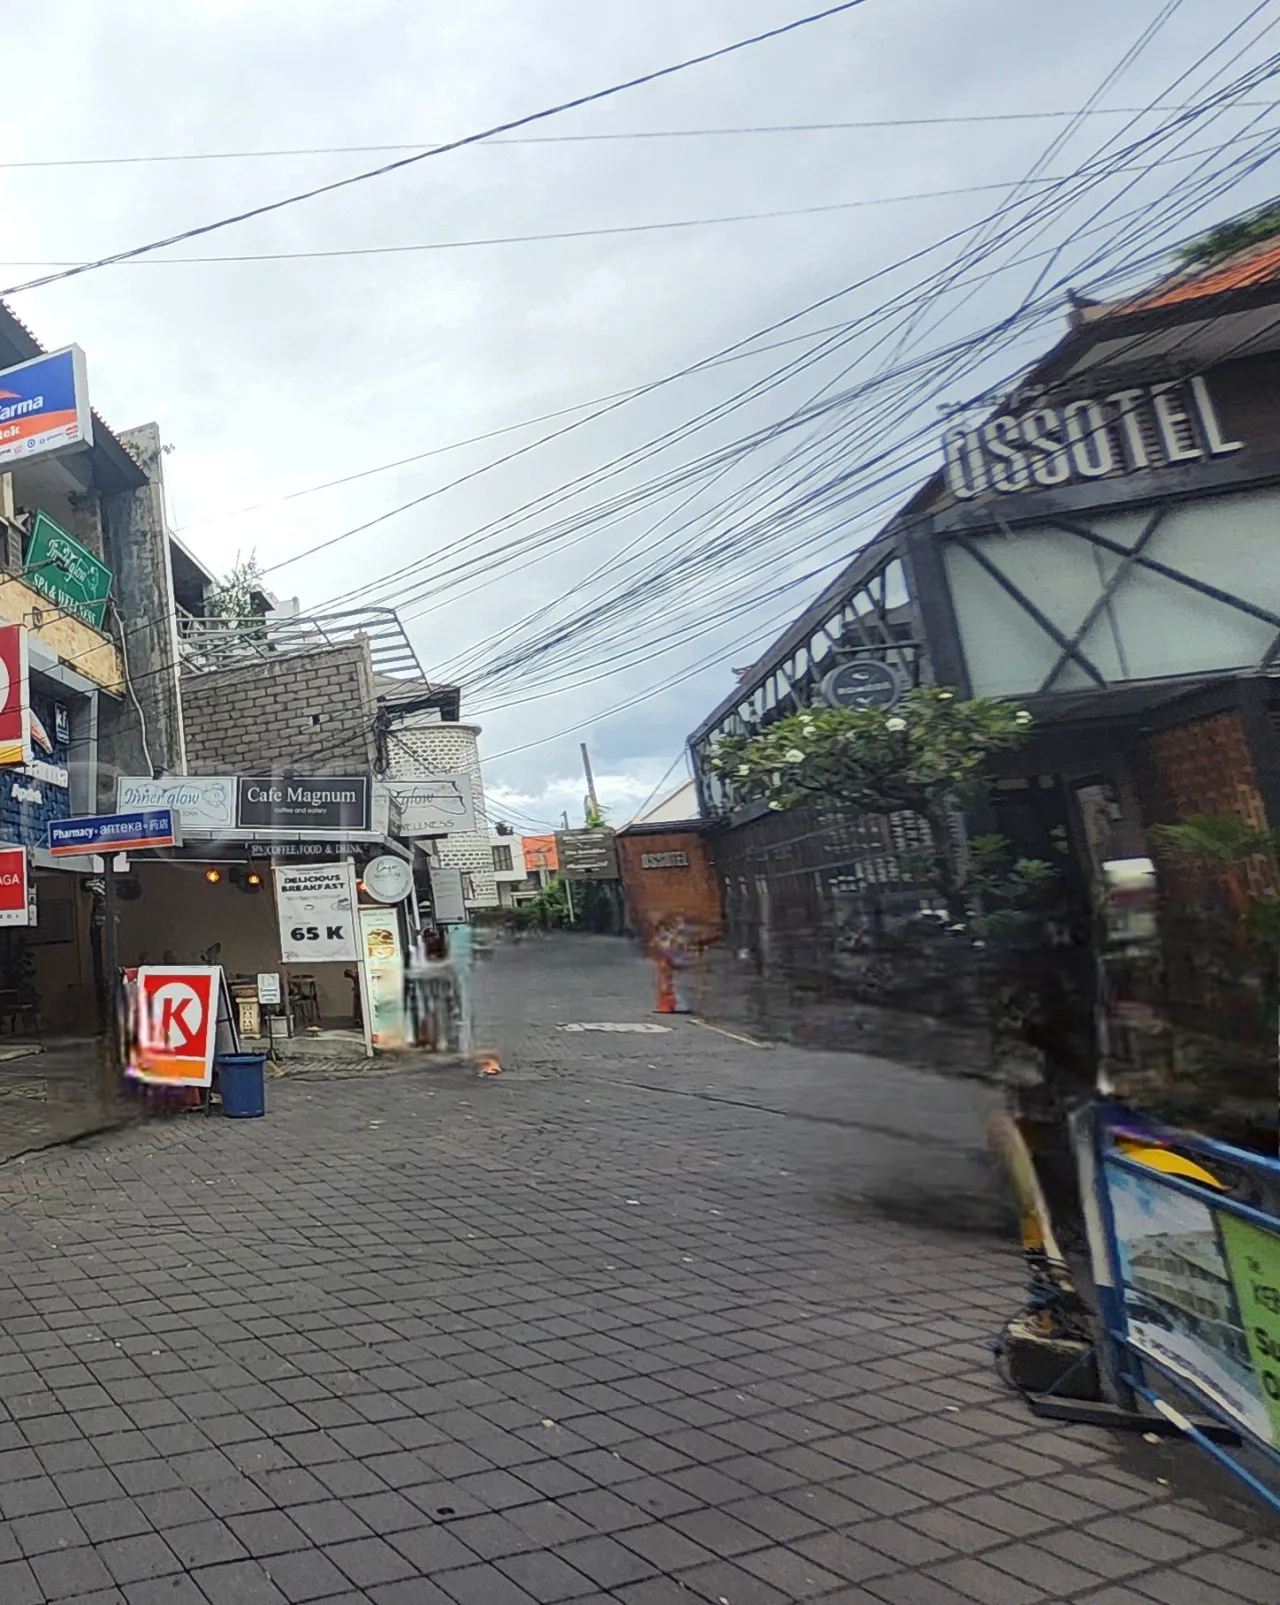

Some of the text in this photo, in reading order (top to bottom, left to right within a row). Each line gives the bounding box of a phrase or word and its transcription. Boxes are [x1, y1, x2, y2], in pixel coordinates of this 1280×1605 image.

[942, 376, 1246, 499] OSSOTEL
[33, 573, 48, 595] SPA
[49, 585, 56, 599] &
[247, 787, 356, 806] Cafe Magnum
[53, 828, 94, 842] Pharmacy
[100, 821, 143, 835] аптека
[325, 845, 332, 853] &
[284, 874, 341, 883] DELICIOUS
[282, 882, 345, 892] BREAKFAST
[290, 926, 344, 941] 65 K
[162, 998, 195, 1043] K
